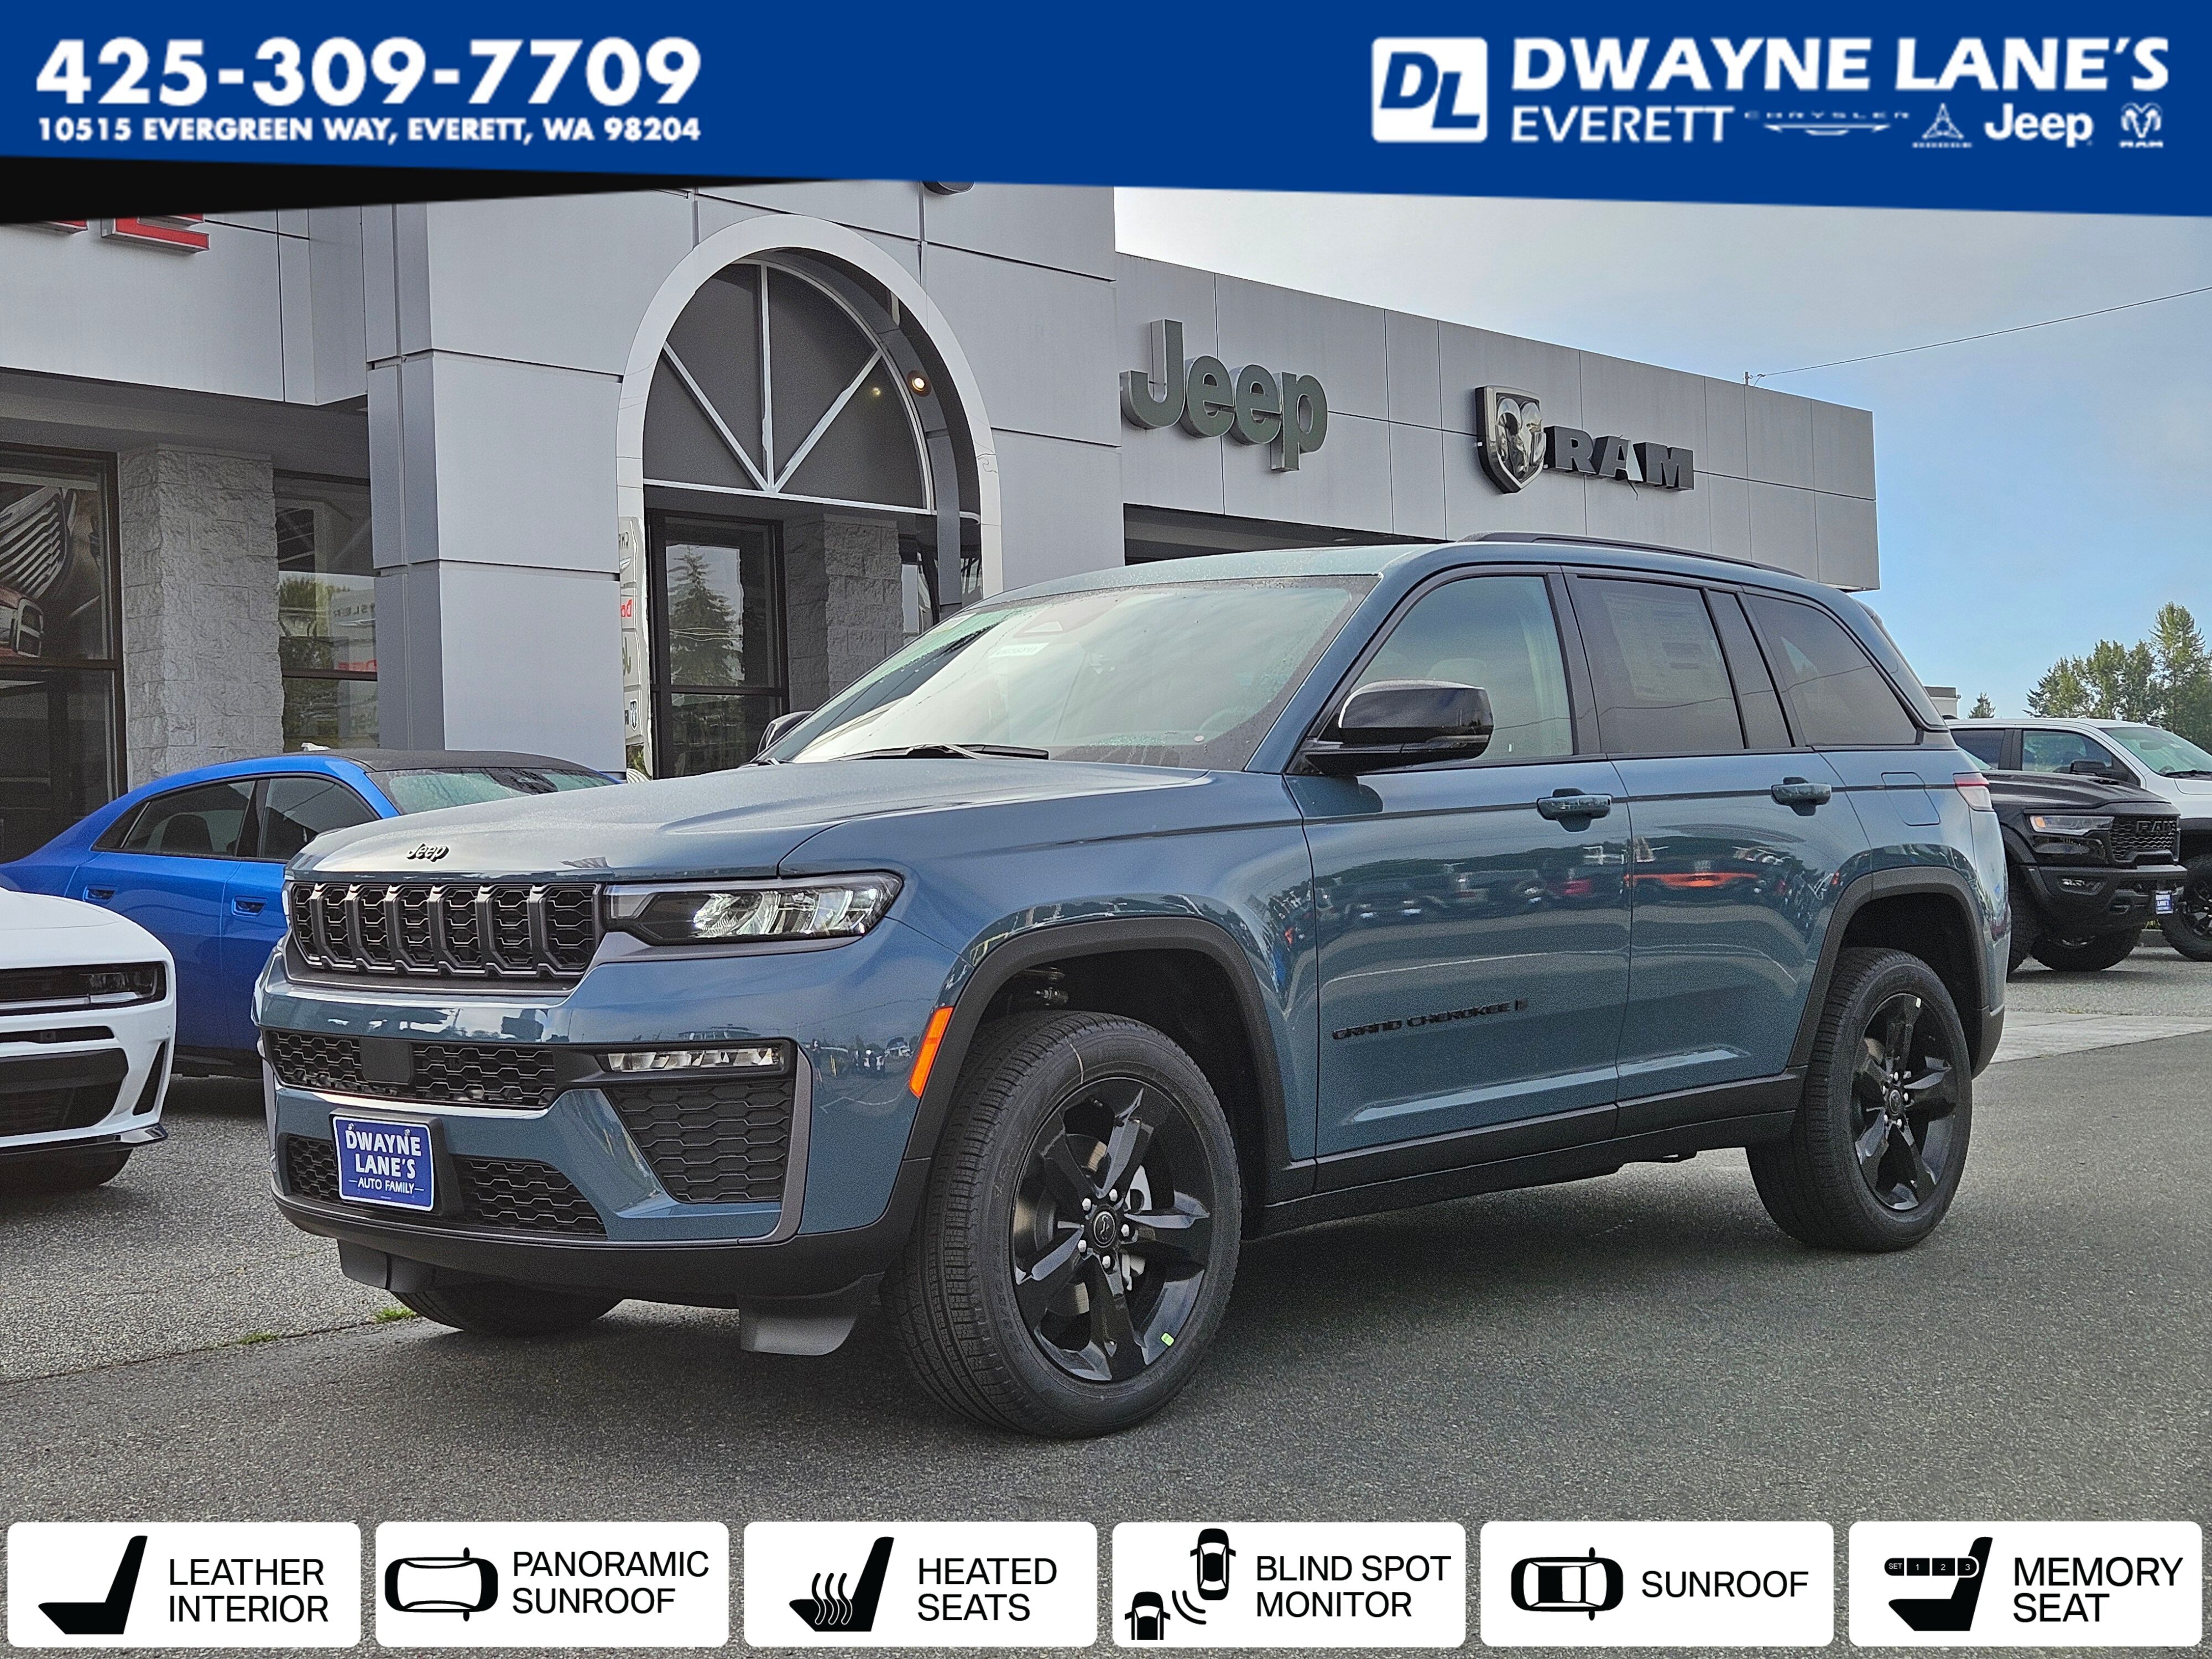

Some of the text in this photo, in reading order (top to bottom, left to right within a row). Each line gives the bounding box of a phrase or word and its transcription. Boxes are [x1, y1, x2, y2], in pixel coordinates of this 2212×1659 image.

[1120, 319, 1328, 472] Jeep
[1542, 425, 1694, 490] RAM
[406, 843, 449, 862] Jeep
[1332, 1001, 1511, 1040] GRAND CHEROKEE
[345, 1130, 422, 1156] DWAYNE
[355, 1153, 416, 1179] LANE'S
[358, 1177, 415, 1194] AUTO FAMILY
